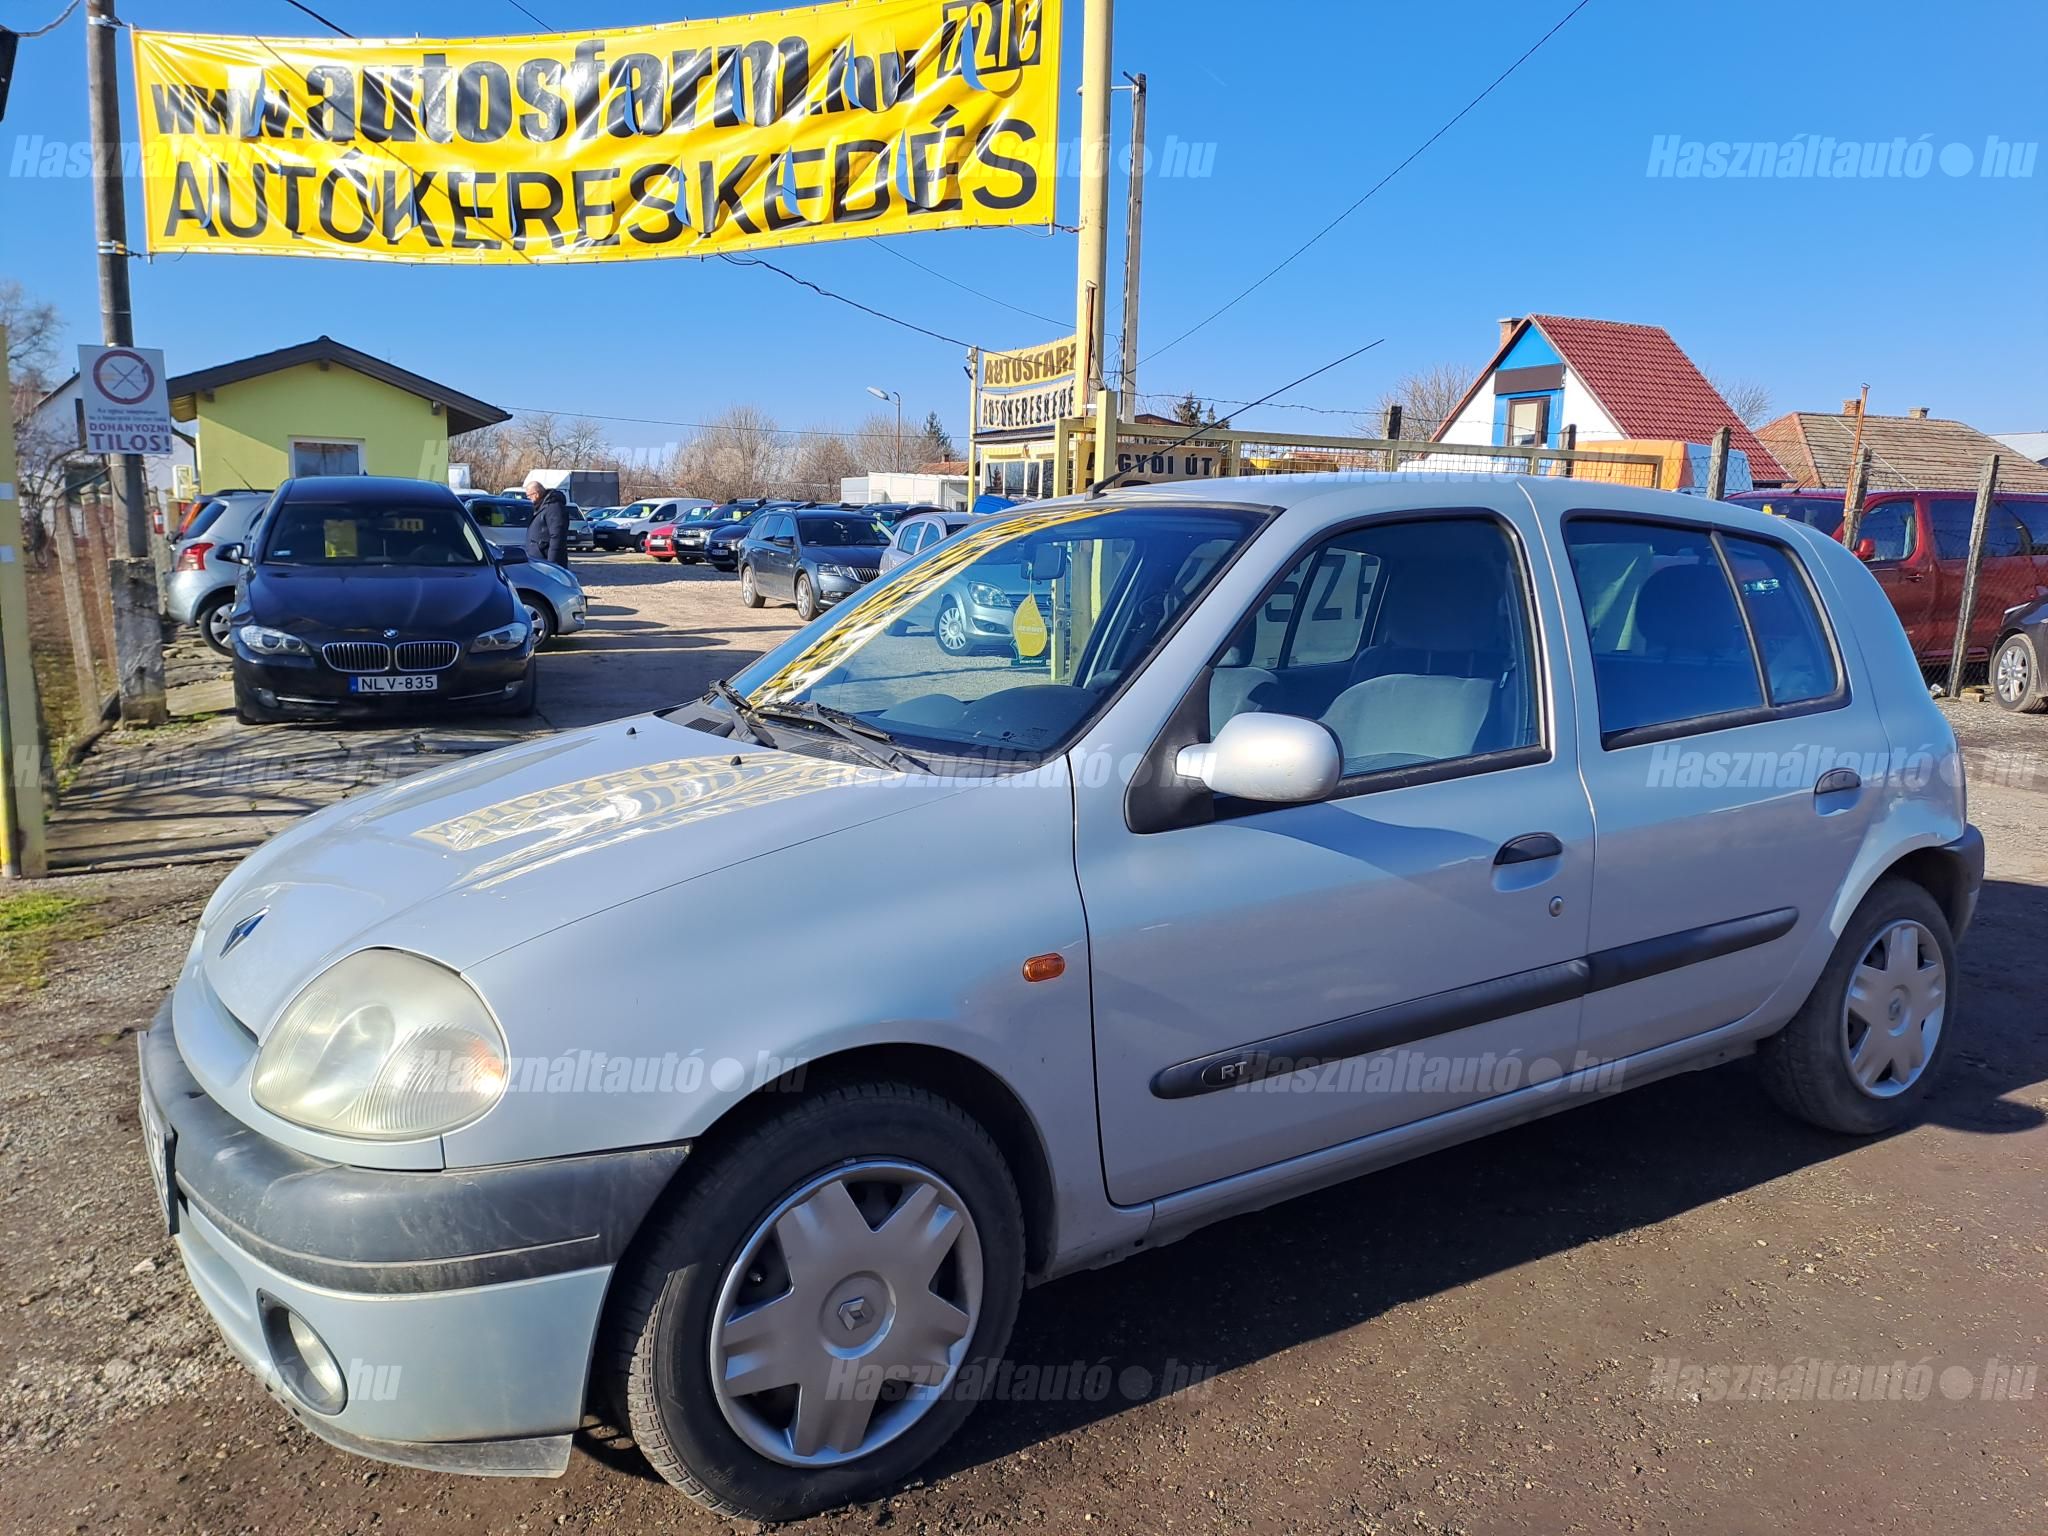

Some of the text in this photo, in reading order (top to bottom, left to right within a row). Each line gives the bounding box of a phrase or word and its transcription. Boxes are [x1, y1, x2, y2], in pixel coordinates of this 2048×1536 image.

[164, 103, 1038, 250] AUTÓKERESKEDÉS
[1185, 453, 1213, 476] ÚT
[361, 677, 434, 690] NLV-835
[1221, 1061, 1247, 1080] RT
